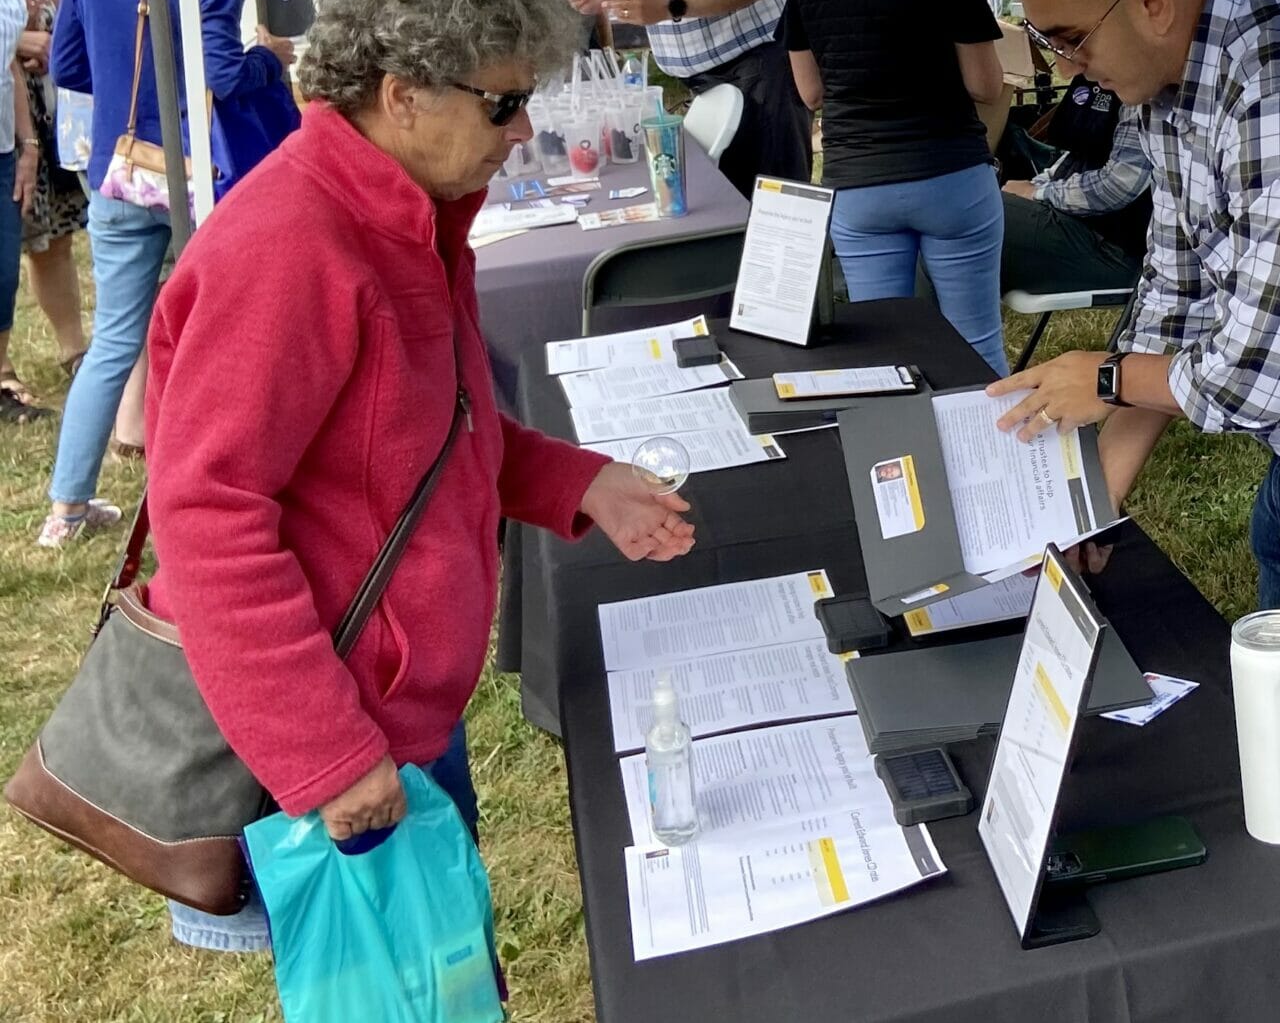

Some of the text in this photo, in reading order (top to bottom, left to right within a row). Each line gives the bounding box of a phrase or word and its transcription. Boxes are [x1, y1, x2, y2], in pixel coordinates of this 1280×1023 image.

[1038, 439, 1049, 468] trustee
[1029, 448, 1041, 483] financial
[1035, 483, 1046, 510] affairs
[1043, 469, 1050, 478] to
[1044, 479, 1054, 498] help
